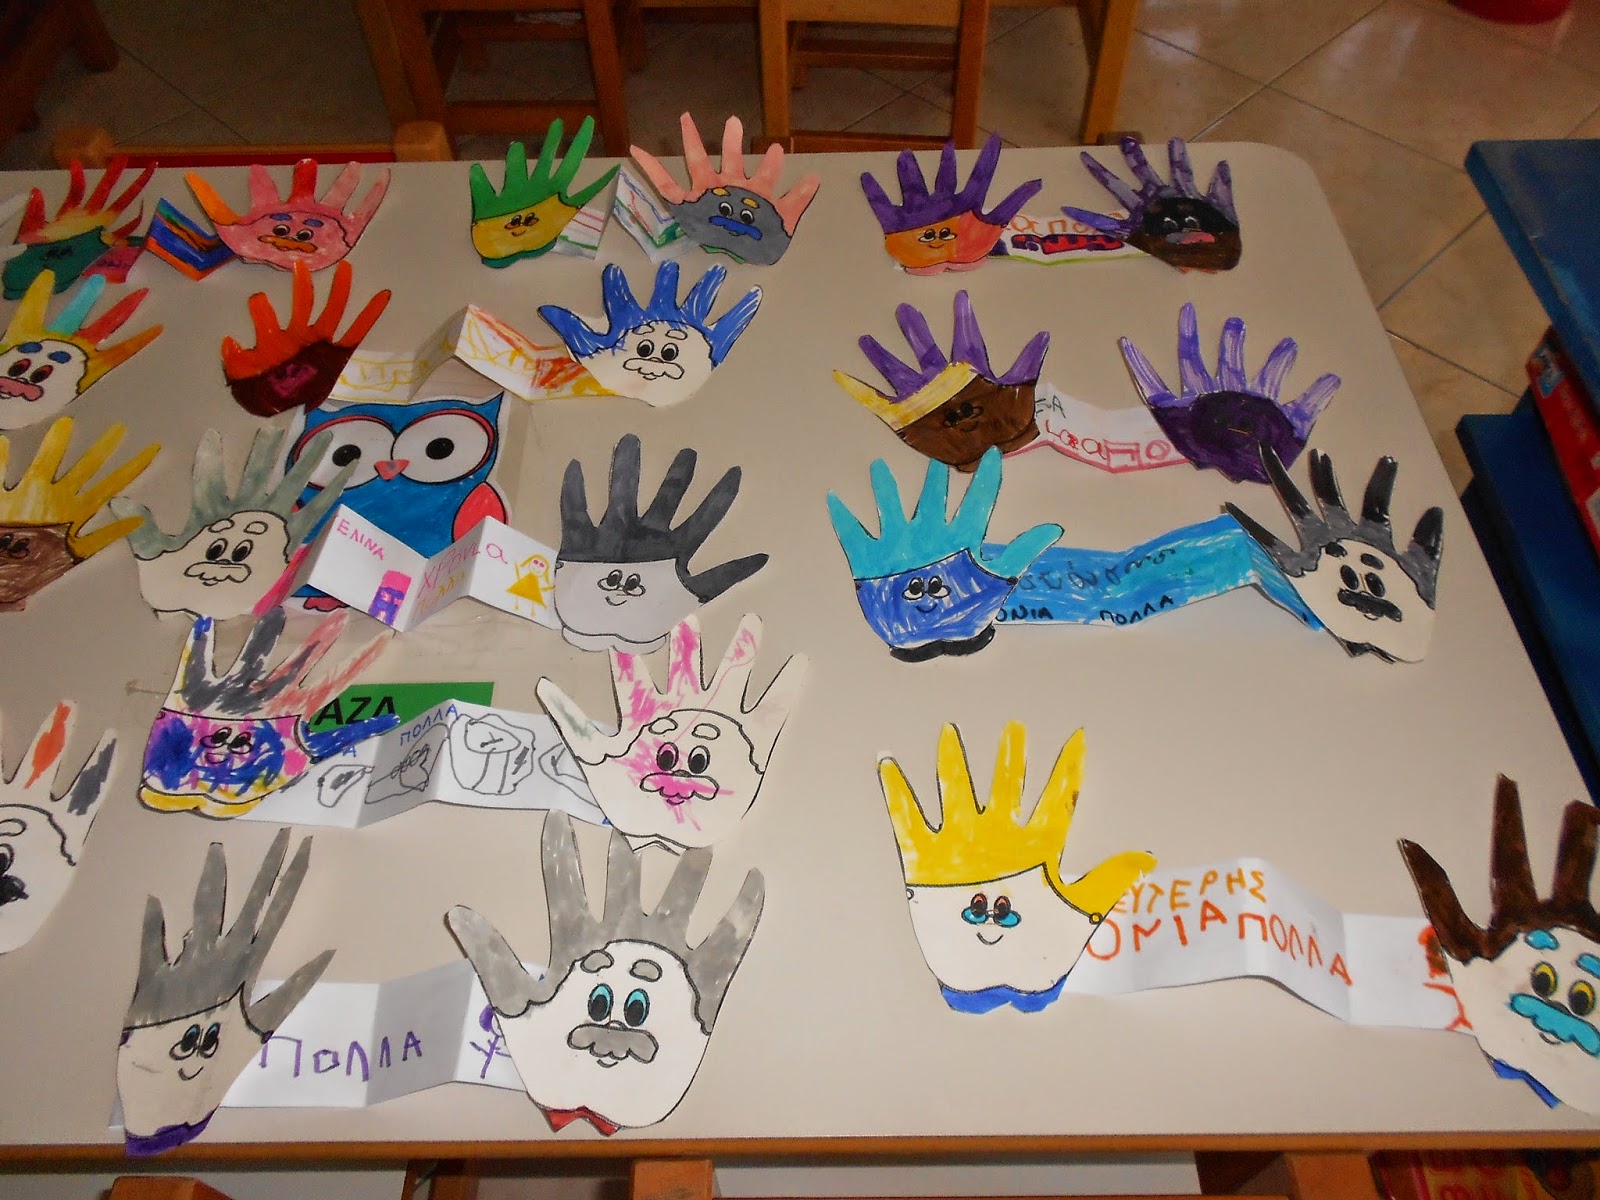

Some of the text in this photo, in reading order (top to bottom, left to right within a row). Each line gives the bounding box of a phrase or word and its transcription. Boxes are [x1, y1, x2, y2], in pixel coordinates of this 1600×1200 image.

[1099, 595, 1174, 625] ΠΟΛΛΑ
[399, 703, 459, 746] ΠΟΛΛΑ
[1238, 912, 1353, 986] ΠΟΛΛΑ
[259, 1031, 423, 1083] ΠΟΛΛΑ
